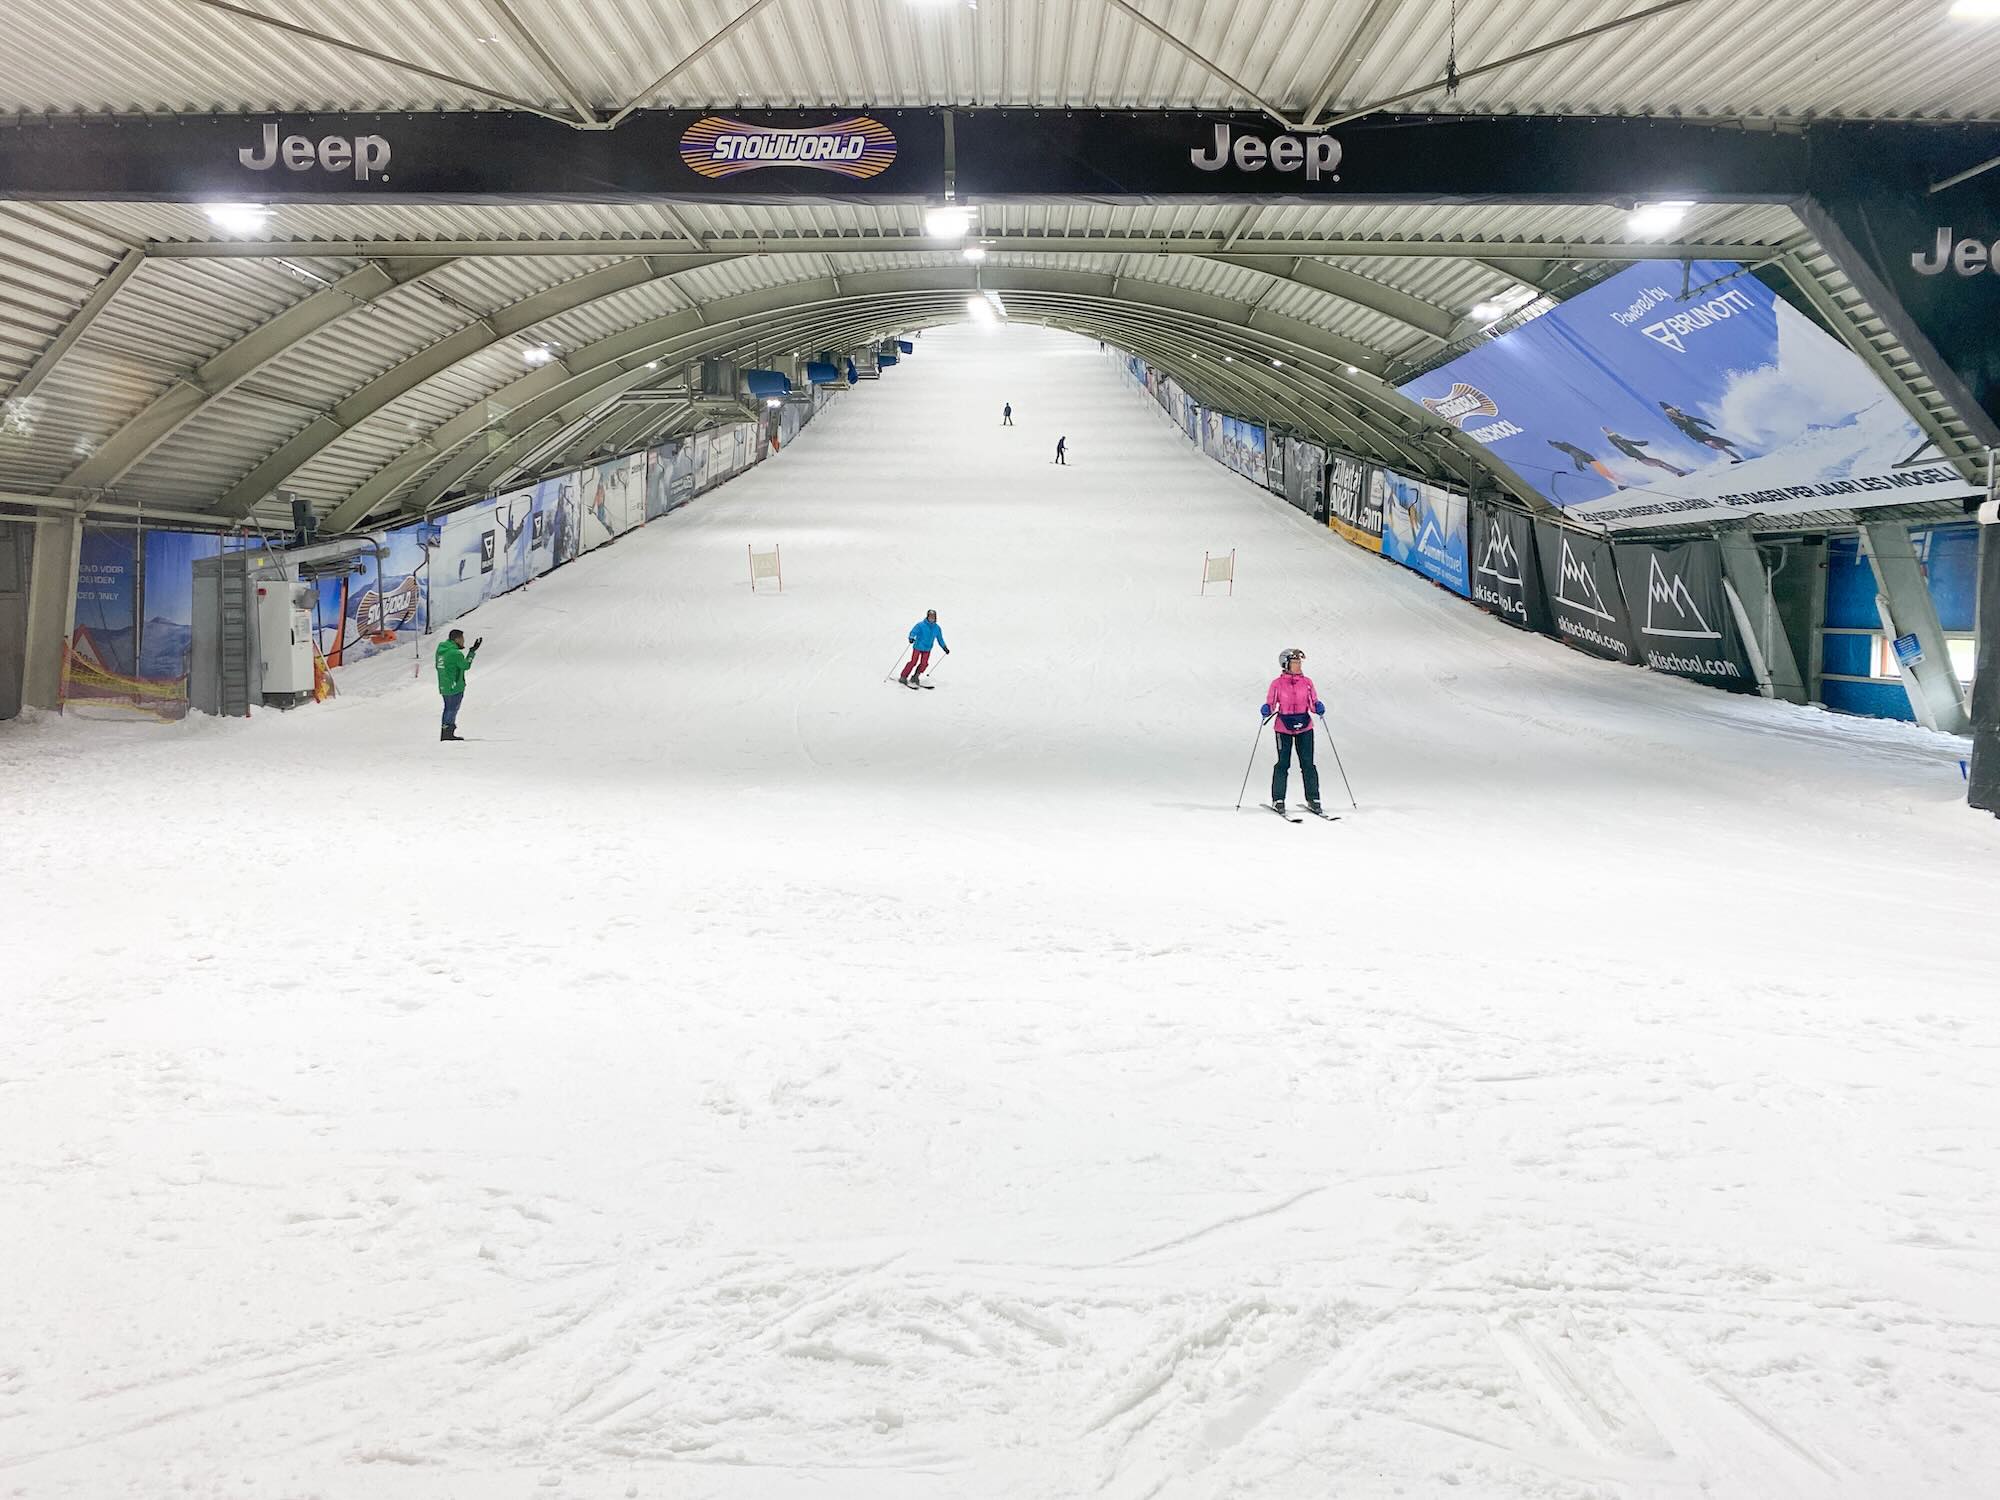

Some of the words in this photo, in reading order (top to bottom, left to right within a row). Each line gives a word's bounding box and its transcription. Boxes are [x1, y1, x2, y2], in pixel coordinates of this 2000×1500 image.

[239, 123, 391, 181] Jeep
[712, 134, 865, 160] SNOWWORLD
[1190, 123, 1343, 181] Jeep
[1912, 227, 2000, 276] Je
[1609, 288, 1656, 327] Powered
[1649, 286, 1673, 306] by
[1665, 289, 1755, 336] BRUNOTTI
[1744, 487, 1793, 504] DAGEN
[1785, 484, 1820, 499] PER
[1814, 479, 1862, 497] JAAR
[1852, 475, 1893, 492] LES
[1557, 614, 1628, 657] skischool.com
[1648, 649, 1741, 678] skischool.com
